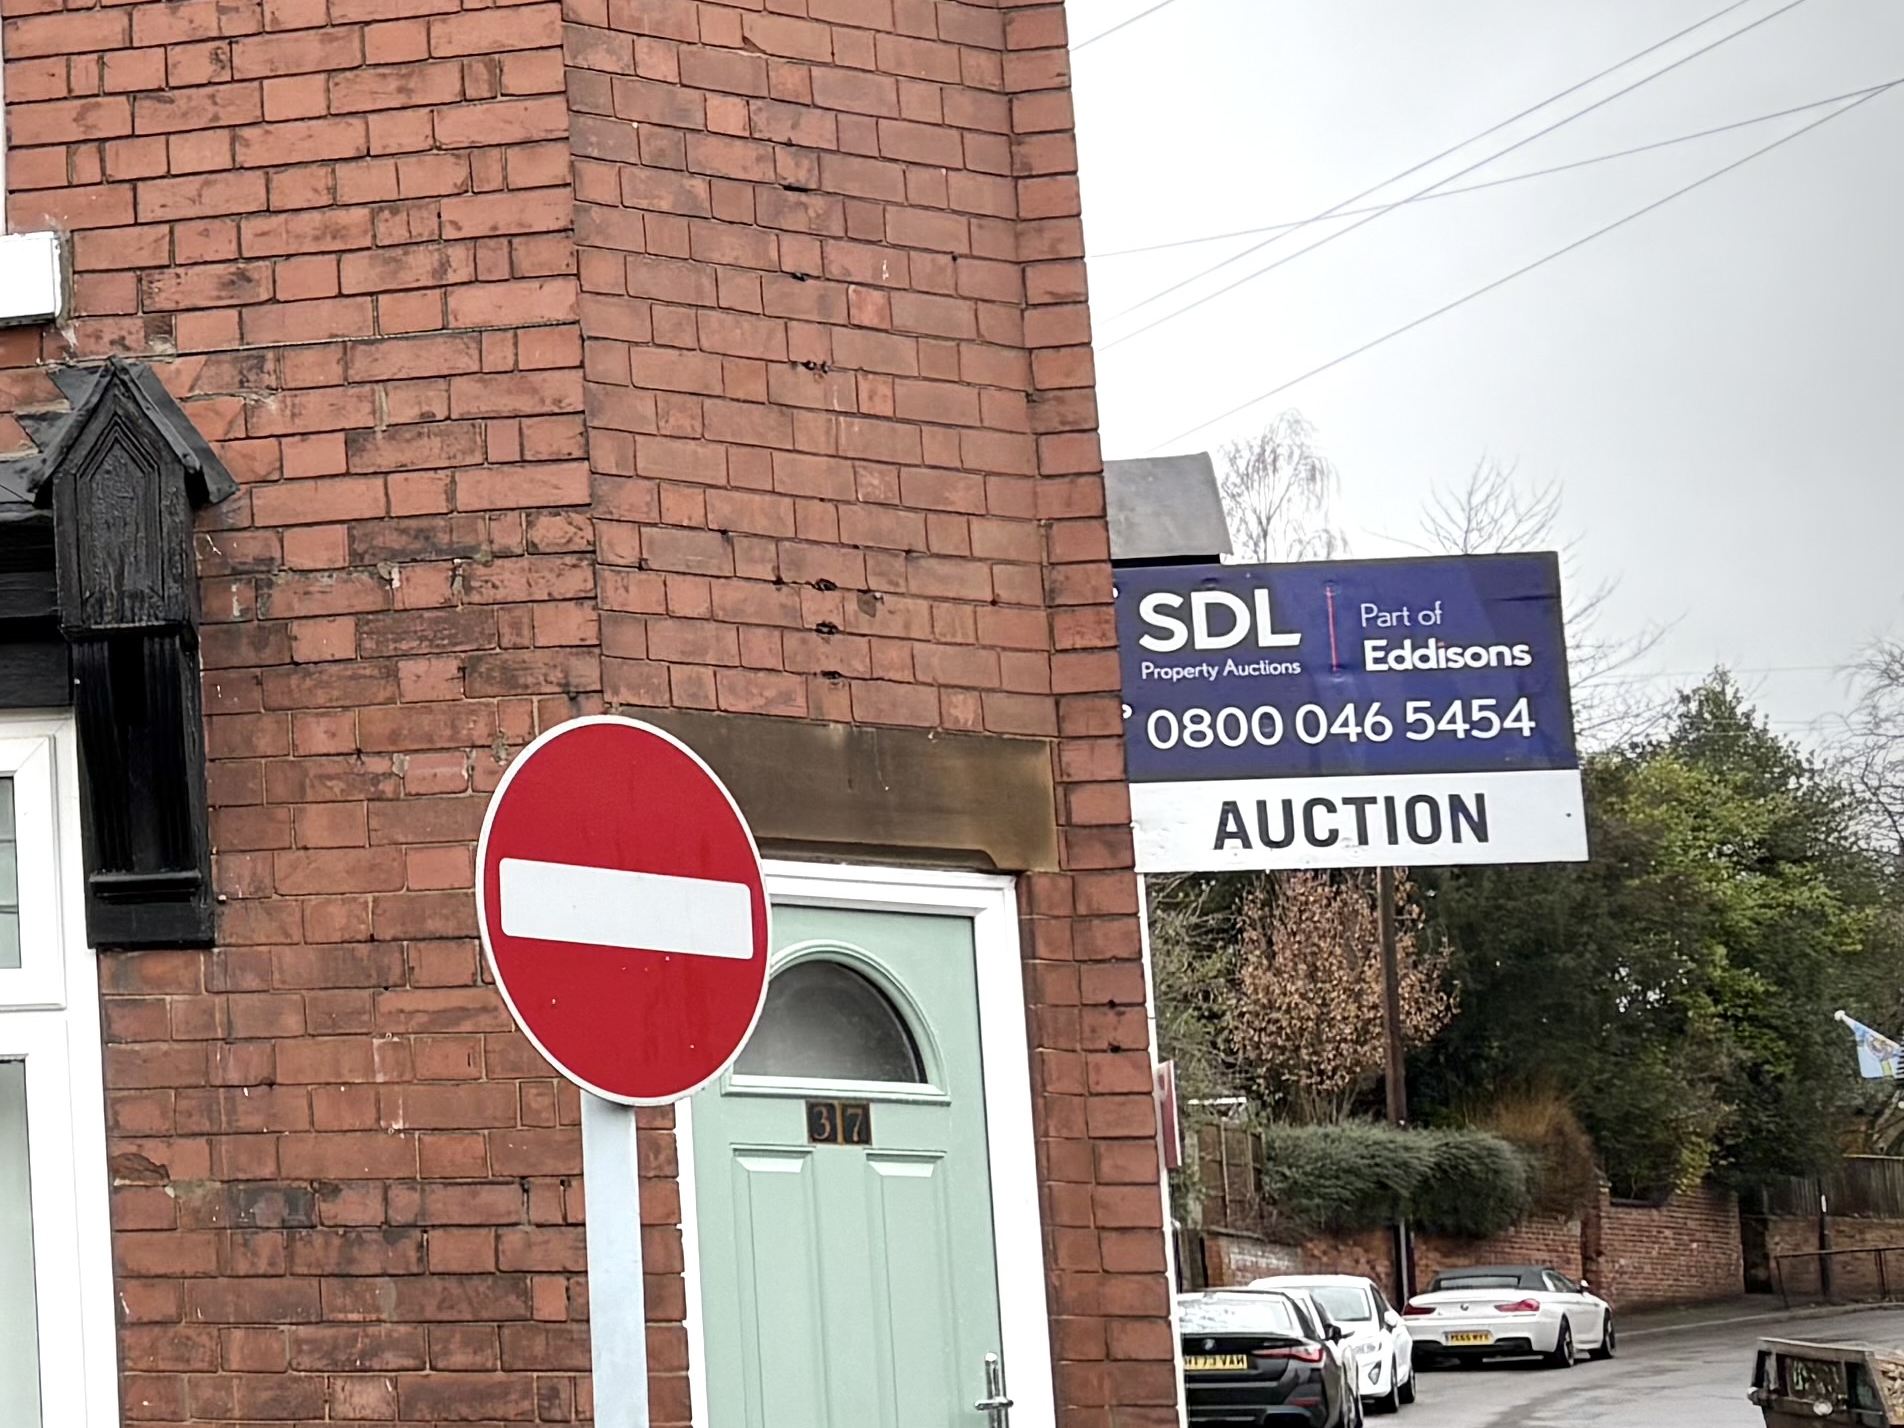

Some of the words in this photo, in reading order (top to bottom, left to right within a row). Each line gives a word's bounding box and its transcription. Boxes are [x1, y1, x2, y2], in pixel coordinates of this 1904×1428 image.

[1138, 588, 1302, 653] SDL
[1360, 603, 1411, 628] Part
[1417, 600, 1443, 626] of
[1141, 660, 1219, 682] Property
[1222, 658, 1302, 677] Auctions
[1363, 637, 1533, 671] Eddisons
[1146, 705, 1284, 750] 0800
[1295, 701, 1394, 745] 046
[1405, 697, 1536, 741] 5454
[1213, 792, 1490, 850] AUCTION
[812, 1105, 863, 1143] 37
